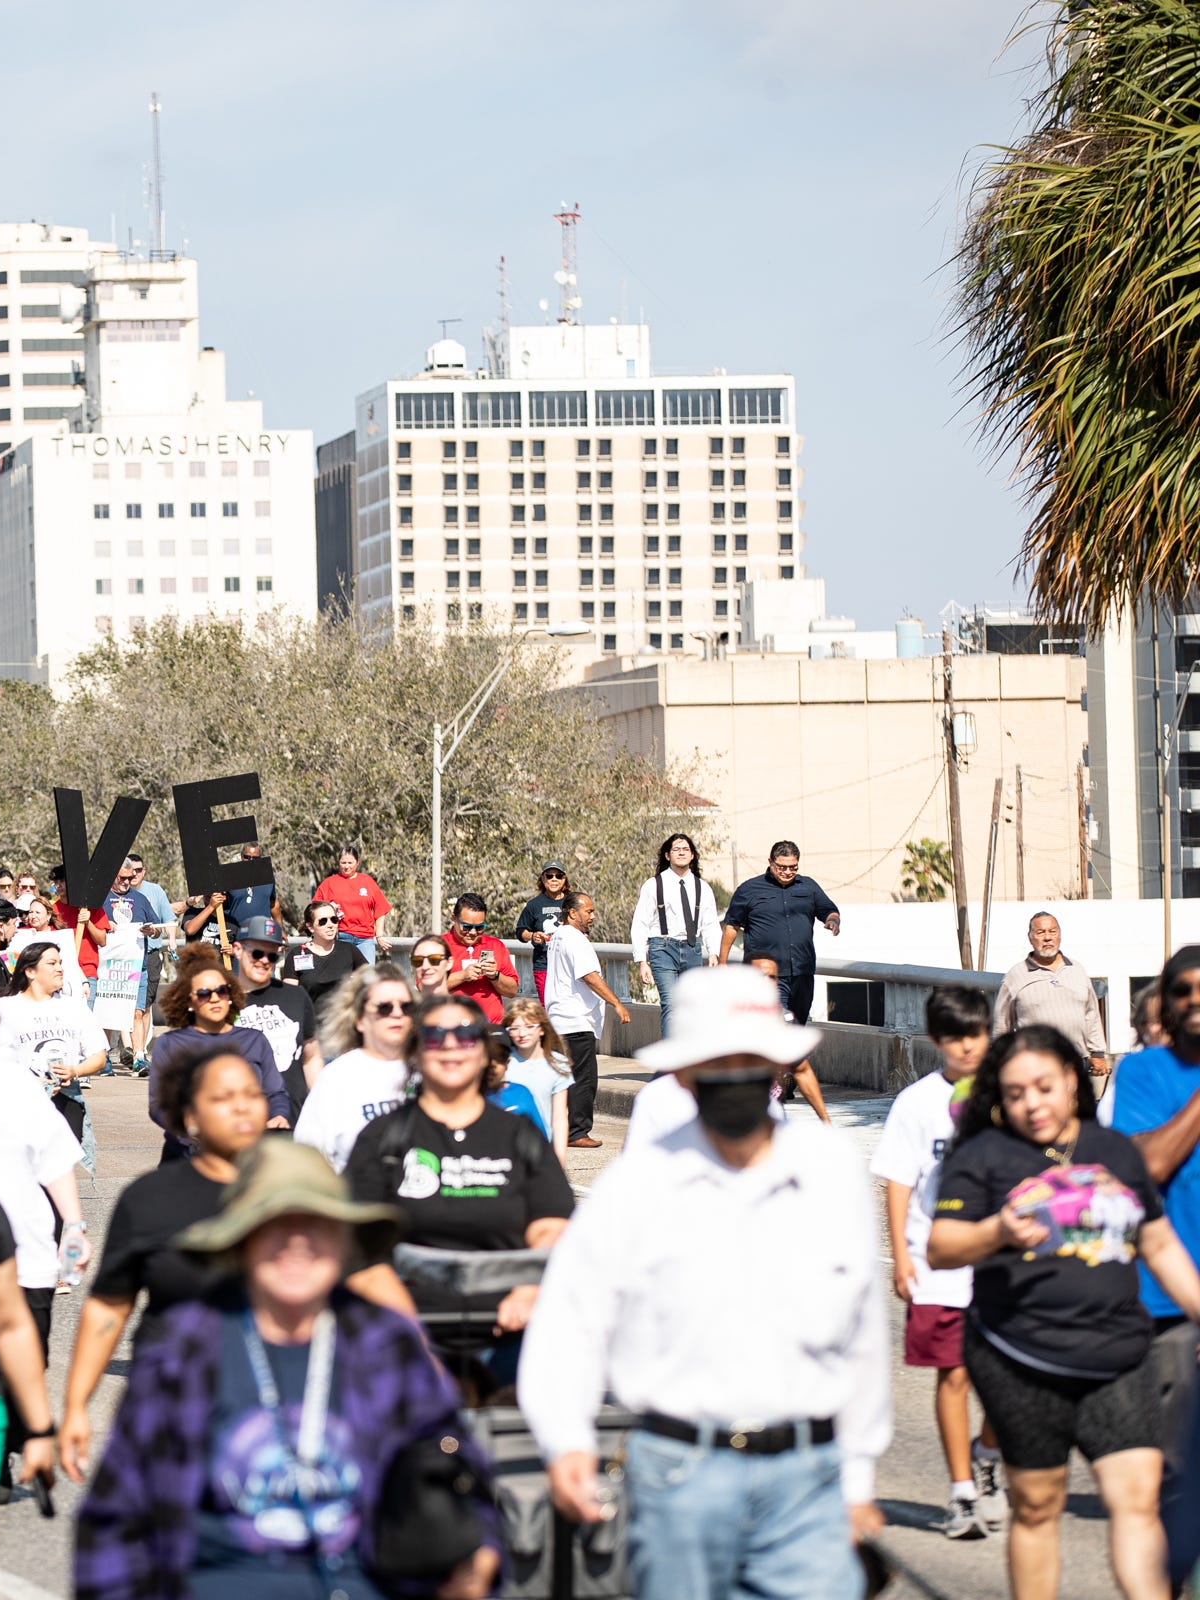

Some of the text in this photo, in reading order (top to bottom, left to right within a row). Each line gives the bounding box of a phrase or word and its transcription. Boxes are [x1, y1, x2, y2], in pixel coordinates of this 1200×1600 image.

[51, 434, 289, 456] THOMAS J HENRY
[240, 1008, 277, 1026] BLACK
